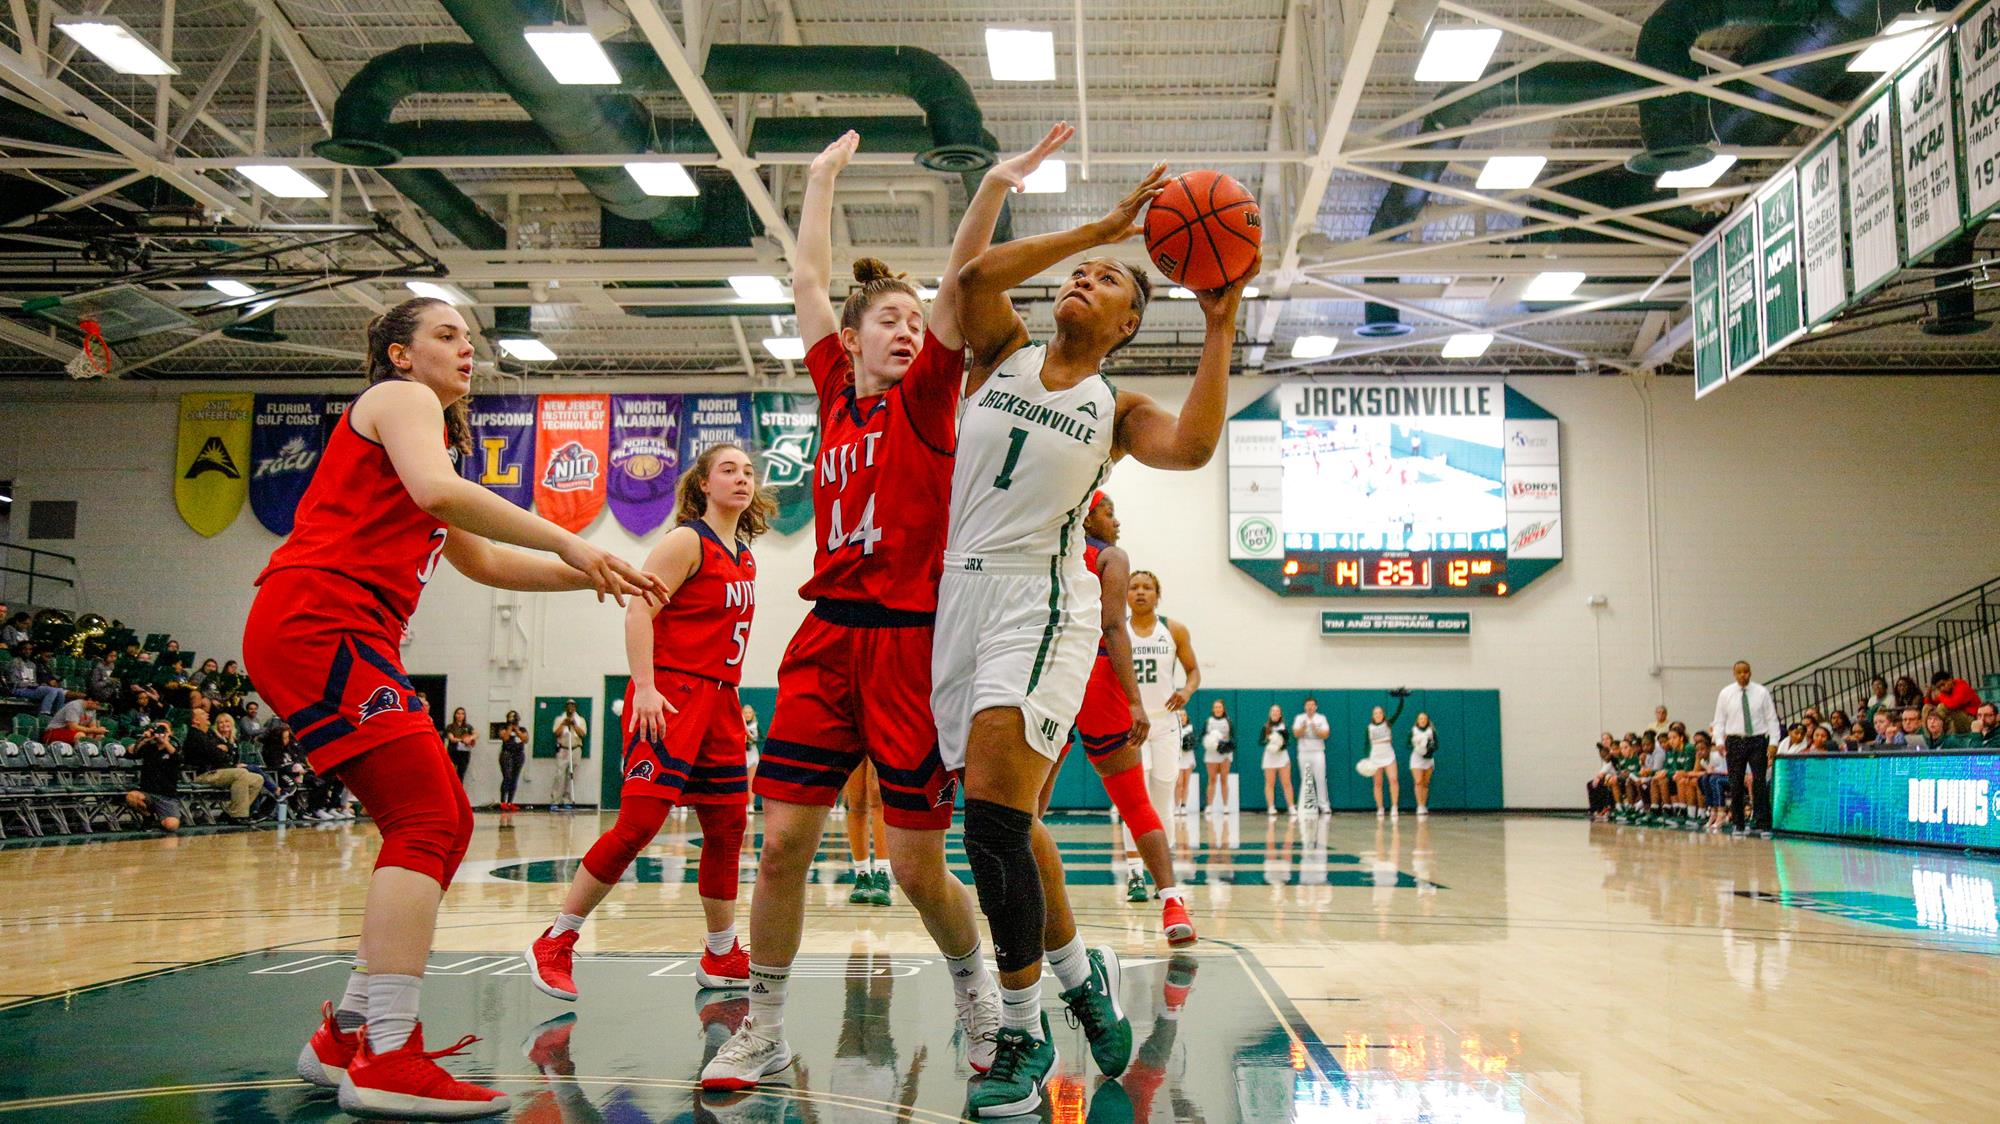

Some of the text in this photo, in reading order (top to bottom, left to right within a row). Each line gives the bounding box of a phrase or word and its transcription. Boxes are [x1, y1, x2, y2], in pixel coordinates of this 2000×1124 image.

[1908, 121, 1945, 172] NCAA
[1854, 184, 1889, 219] CHAMPIONS
[266, 402, 312, 414] FLORIDA
[544, 400, 603, 411] NEW JERSEY
[625, 401, 667, 414] NORTH
[697, 398, 738, 412] NORTH
[1296, 387, 1491, 416] JACKSONVILLE
[256, 414, 321, 426] GULF COAST
[471, 412, 534, 427] LIPSCOMB
[542, 410, 606, 421] INSTITUTE OF
[542, 420, 605, 430] TECHNOLOGY
[615, 414, 676, 428] ALABAMA
[692, 411, 742, 425] FLORIDA
[761, 413, 818, 427] STETSON
[978, 388, 1096, 445] JACKSONVILLE
[700, 429, 735, 442] NORTH
[820, 431, 883, 493] NJIT
[993, 426, 1030, 491] 1
[555, 457, 592, 481] NJIT
[826, 493, 883, 556] 44
[964, 557, 983, 571] JAX
[1336, 560, 1358, 586] 14
[1377, 559, 1429, 587] 2:51
[1447, 559, 1469, 587] 12
[1325, 620, 1468, 629] TIM AND STEPHANIE COST
[725, 621, 750, 666] 5
[1133, 658, 1157, 684] 22
[1908, 778, 1989, 826] DOLPHINS
